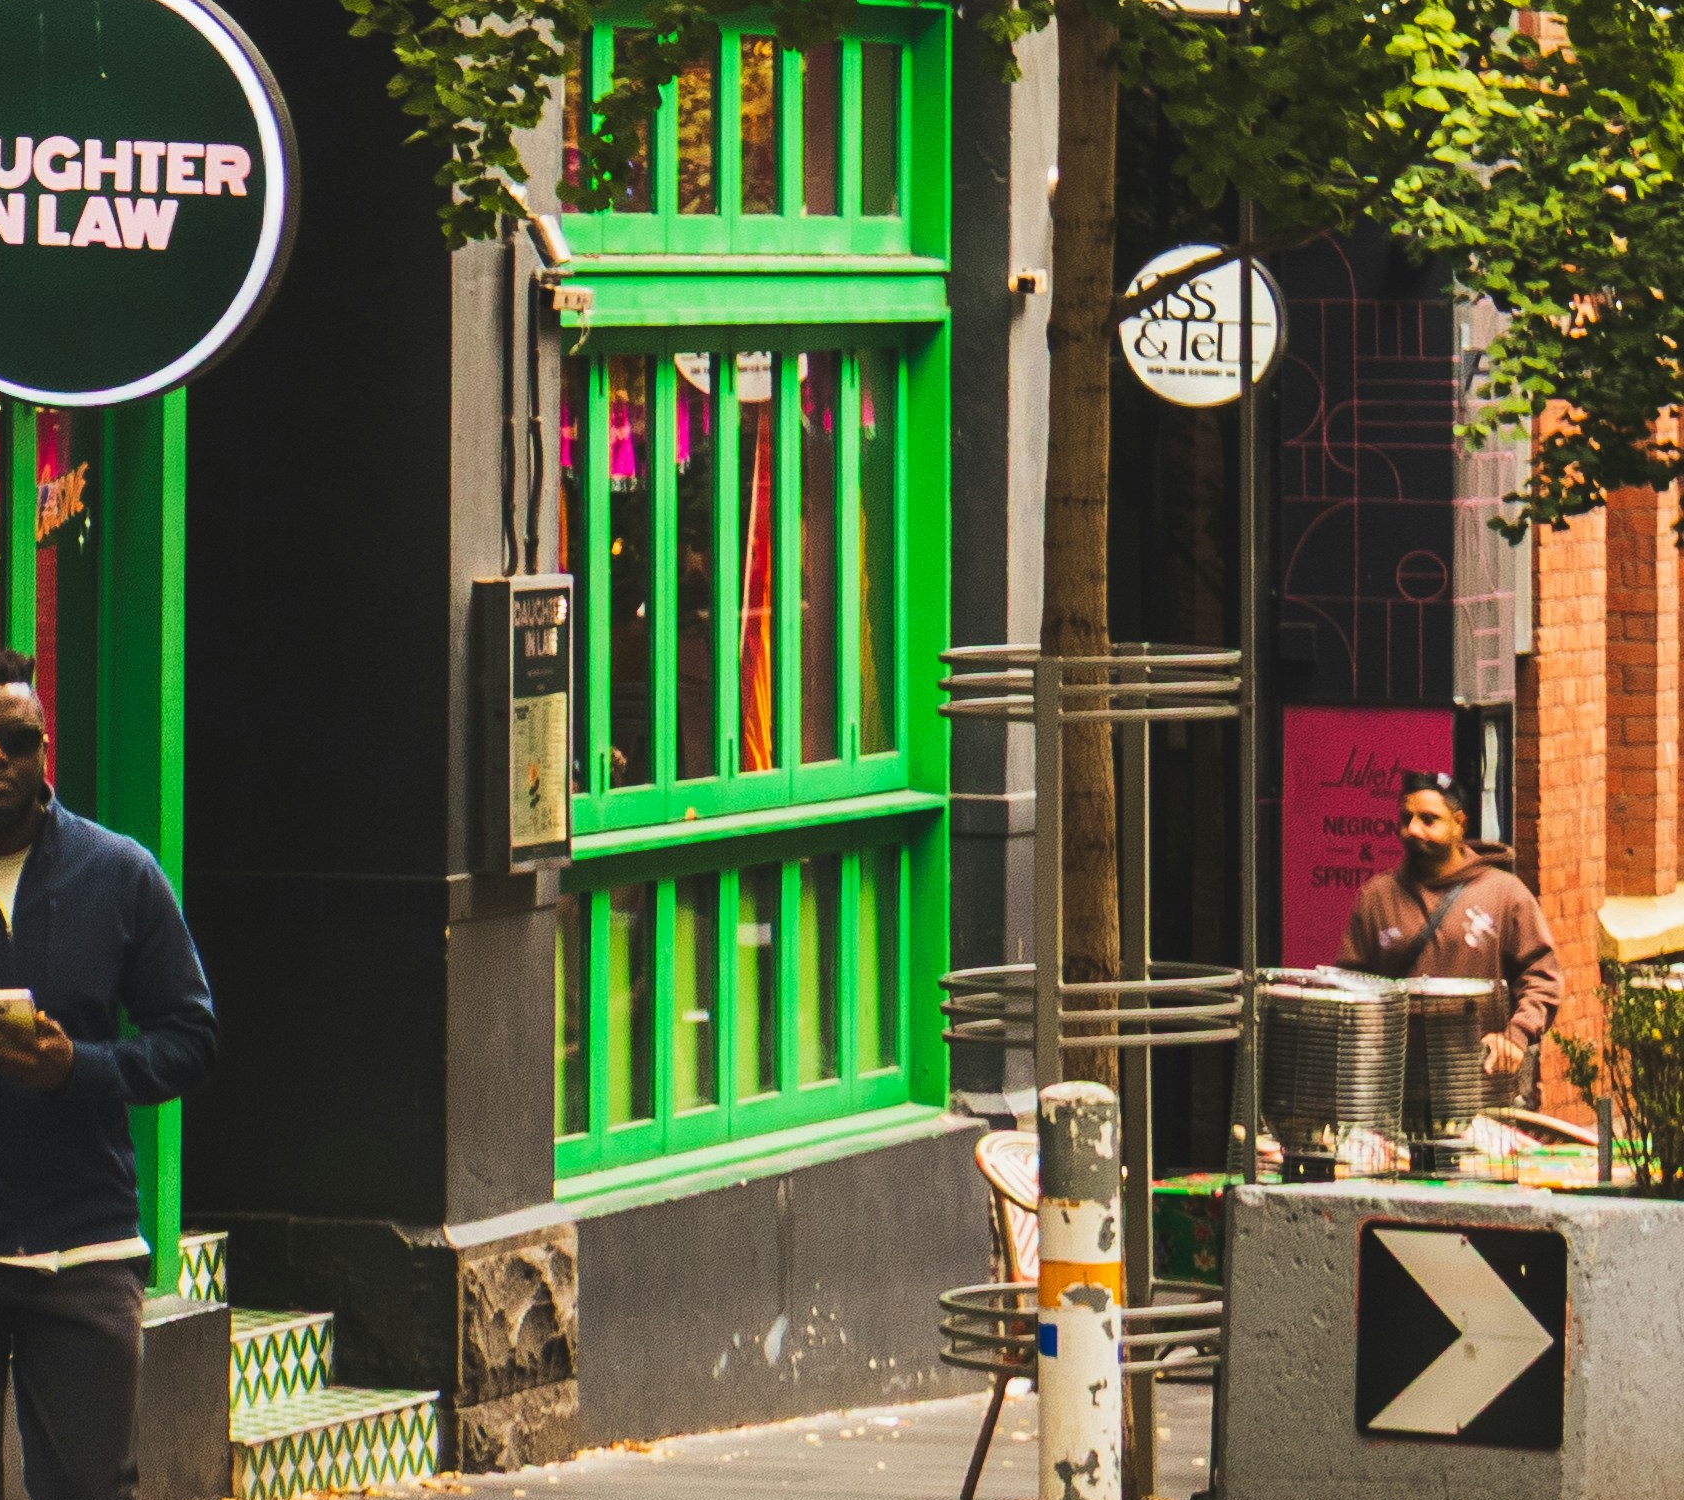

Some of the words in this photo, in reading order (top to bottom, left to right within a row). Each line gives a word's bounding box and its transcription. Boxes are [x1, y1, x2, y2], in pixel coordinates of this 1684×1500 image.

[37, 193, 179, 251] LAW
[1134, 320, 1168, 359] &
[1322, 815, 1402, 838] NEGRON
